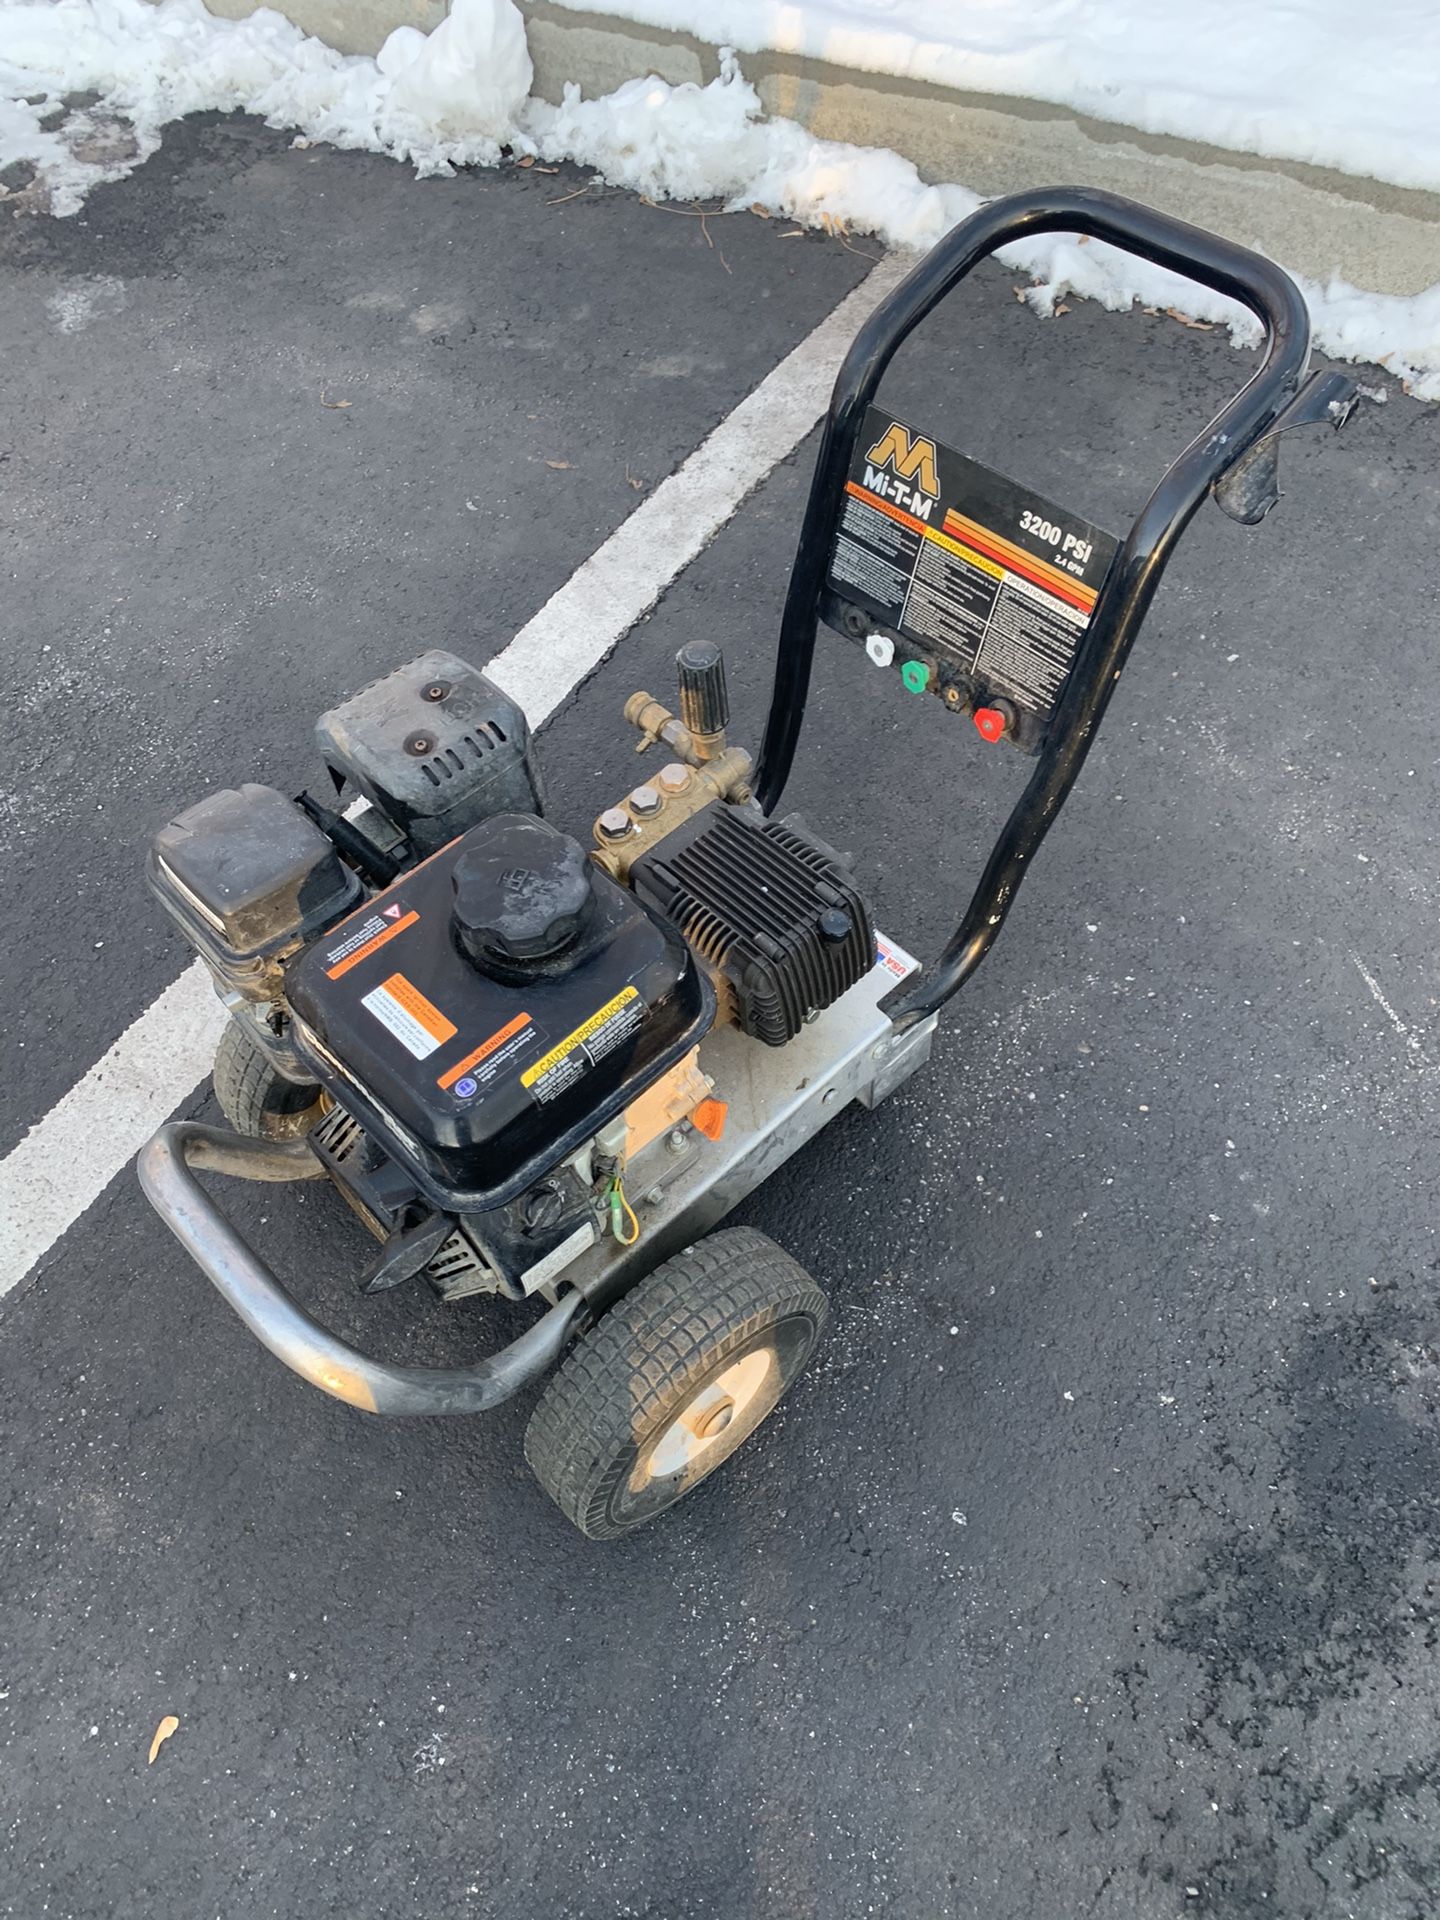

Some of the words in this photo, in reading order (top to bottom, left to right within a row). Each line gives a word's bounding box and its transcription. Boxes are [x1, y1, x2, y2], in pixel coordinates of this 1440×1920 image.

[863, 466, 933, 520] Mi-T-M
[1019, 510, 1062, 547] 3200
[1066, 534, 1093, 564] PSI
[347, 934, 386, 964] WARNING
[884, 956, 906, 975] USA
[471, 1028, 511, 1062] WARNING
